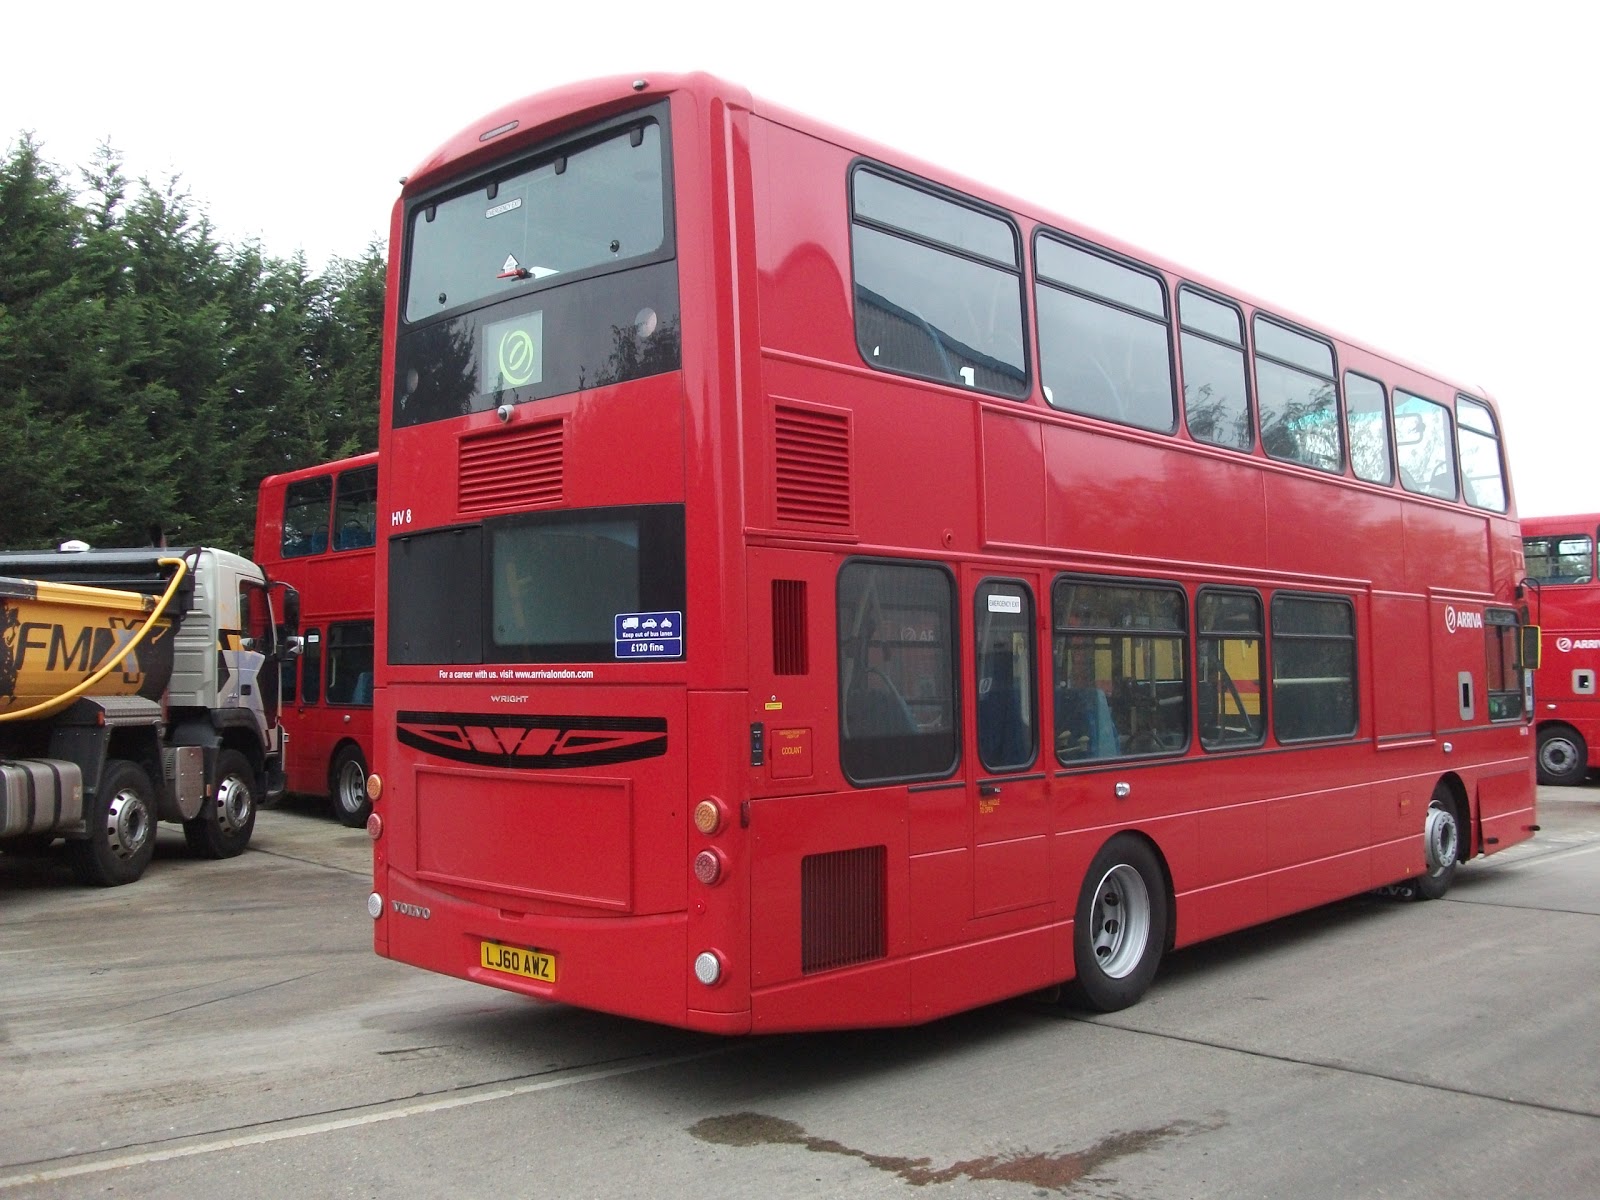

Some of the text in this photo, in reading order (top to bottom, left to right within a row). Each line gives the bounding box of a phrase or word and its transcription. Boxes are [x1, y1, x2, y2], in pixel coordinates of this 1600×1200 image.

[391, 508, 412, 526] HV 8
[989, 599, 1020, 608] EMERGENCY EXIT
[1456, 611, 1483, 628] ARRIVA
[631, 642, 664, 652] £120 fine
[438, 670, 448, 679] For
[474, 670, 488, 679] with
[499, 669, 514, 679] visit
[515, 669, 594, 679] www.arrivalondon.com
[490, 695, 529, 703] WRIGHT
[781, 746, 802, 755] COOLANT
[391, 900, 431, 920] VOLVO
[486, 947, 549, 978] LJ60 AWZ
